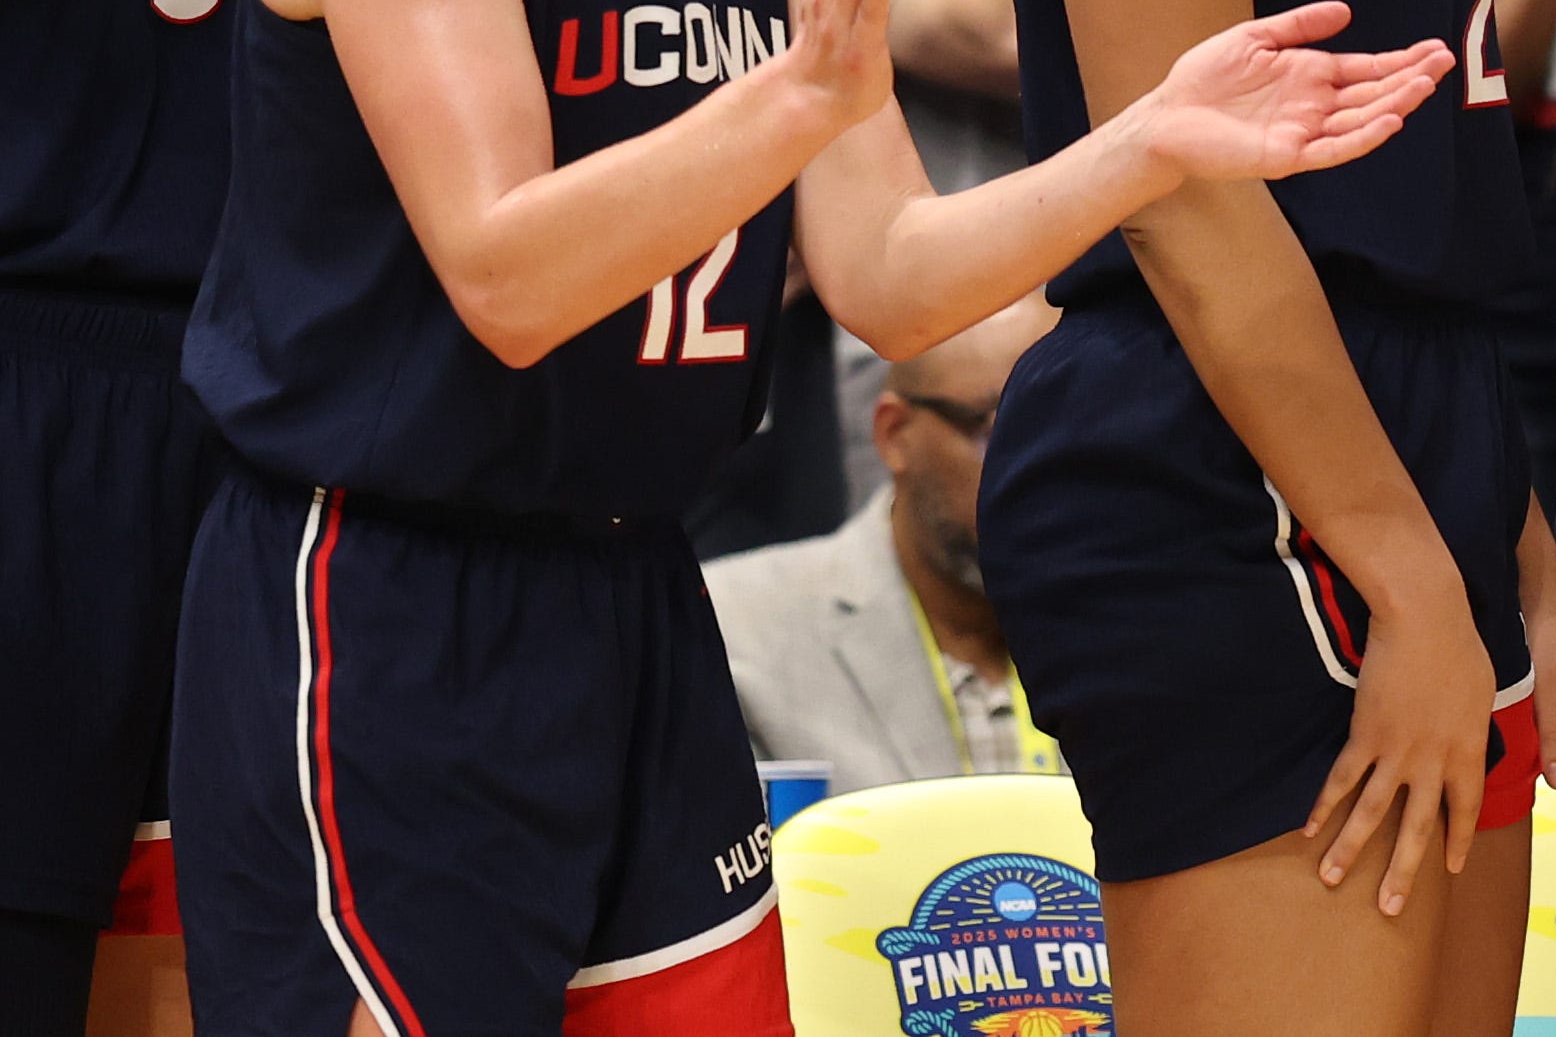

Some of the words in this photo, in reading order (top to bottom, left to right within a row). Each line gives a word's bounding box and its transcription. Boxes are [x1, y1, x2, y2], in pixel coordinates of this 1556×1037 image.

[553, 2, 788, 97] UCONN
[636, 225, 749, 366] 12
[951, 929, 998, 945] 2025
[1004, 925, 1097, 940] WOMEN'S
[898, 942, 1029, 1005] FINAL
[986, 993, 1046, 1008] TAMPA
[1051, 992, 1085, 1005] BAY
